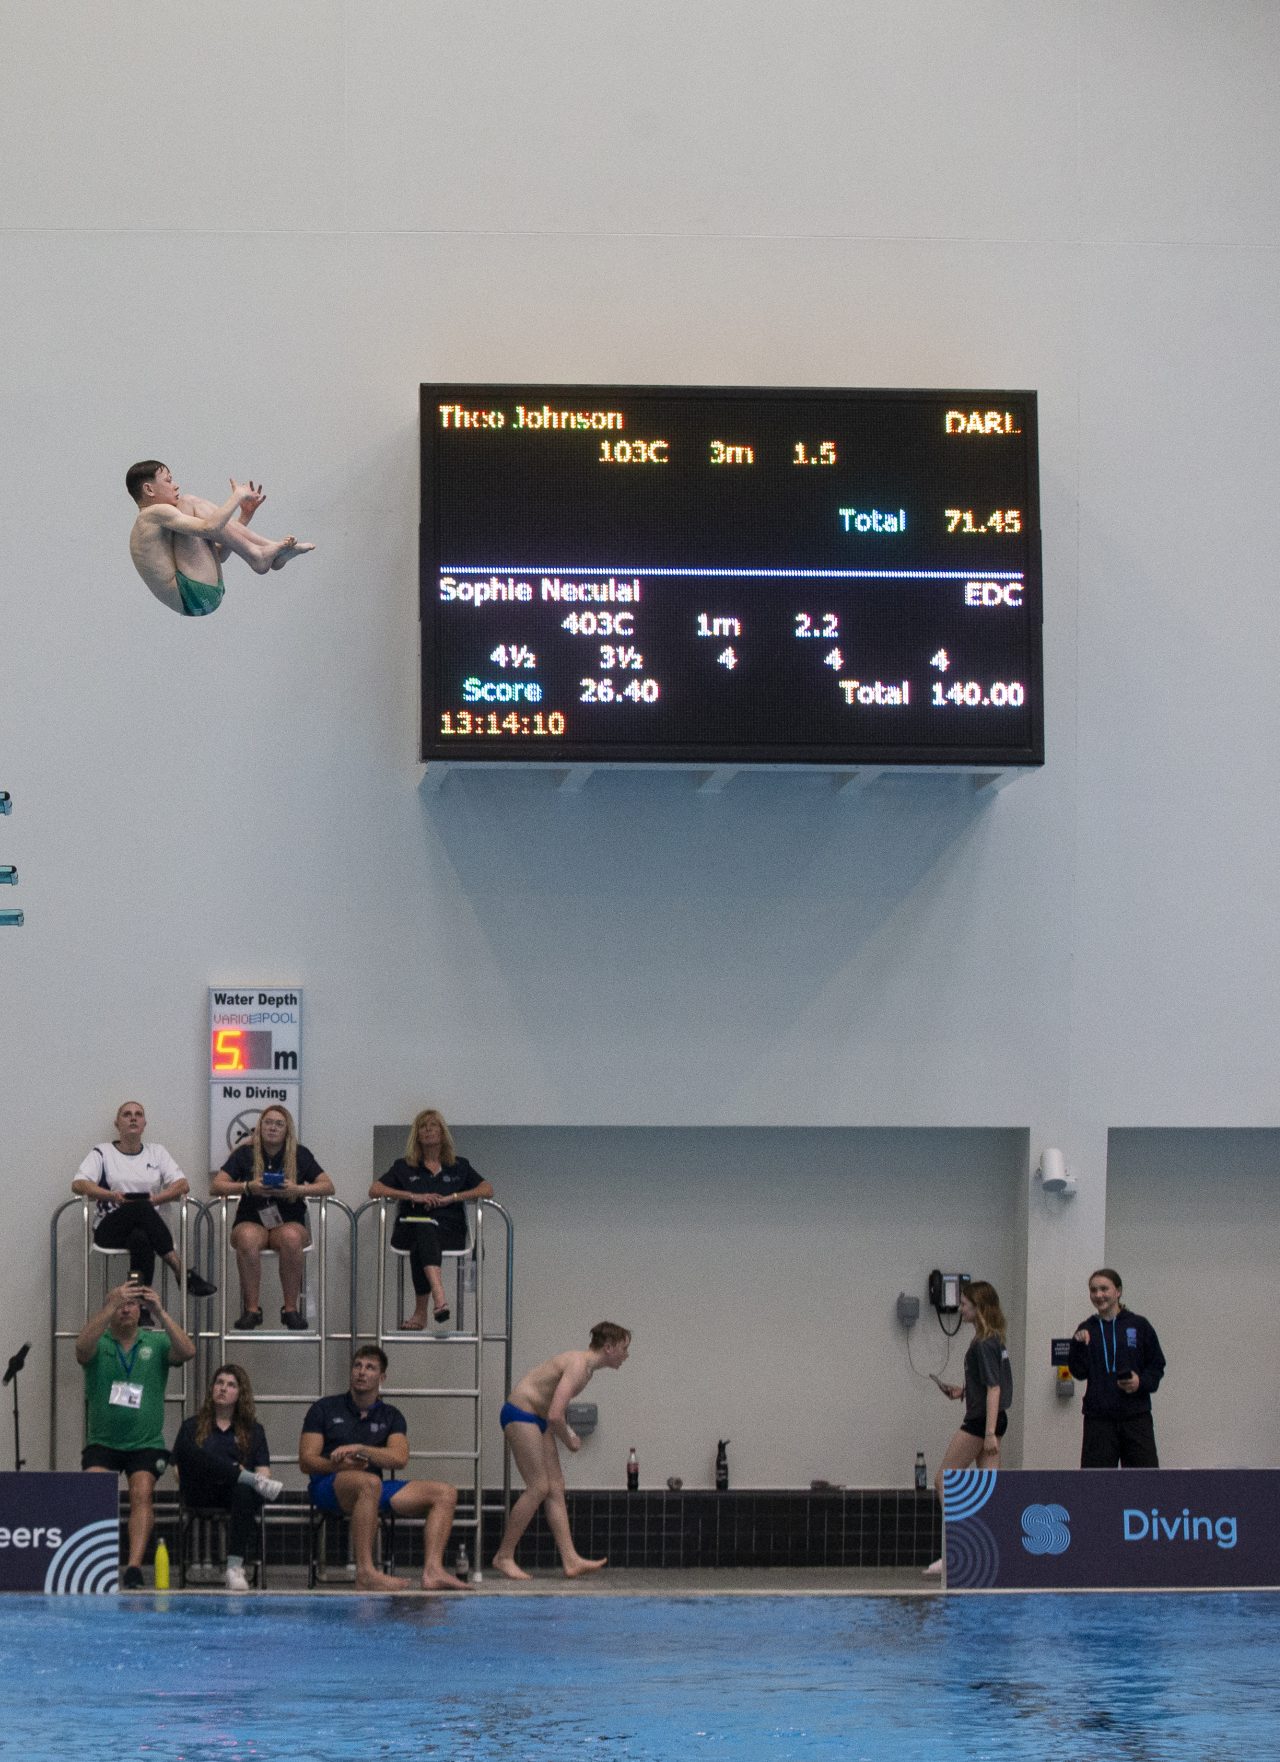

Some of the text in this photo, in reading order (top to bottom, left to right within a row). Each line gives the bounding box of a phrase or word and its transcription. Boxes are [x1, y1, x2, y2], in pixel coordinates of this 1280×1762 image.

[513, 405, 624, 429] Johnson
[598, 440, 837, 465] 103C 3m 1.5
[838, 508, 1022, 533] Total 71.45
[439, 576, 532, 607] Sophie
[964, 582, 1024, 607] EDC
[561, 611, 839, 638] 403C 1m 2.2
[717, 646, 738, 670] 4
[824, 647, 844, 671] 4
[930, 648, 950, 672] 4
[463, 677, 1024, 706] Score 26.40 Total 140.00
[440, 711, 565, 735] 13:14:10
[214, 993, 298, 1008] Water Depth
[274, 1050, 298, 1070] m
[223, 1086, 287, 1101] No Diving
[1123, 1508, 1237, 1549] Diving
